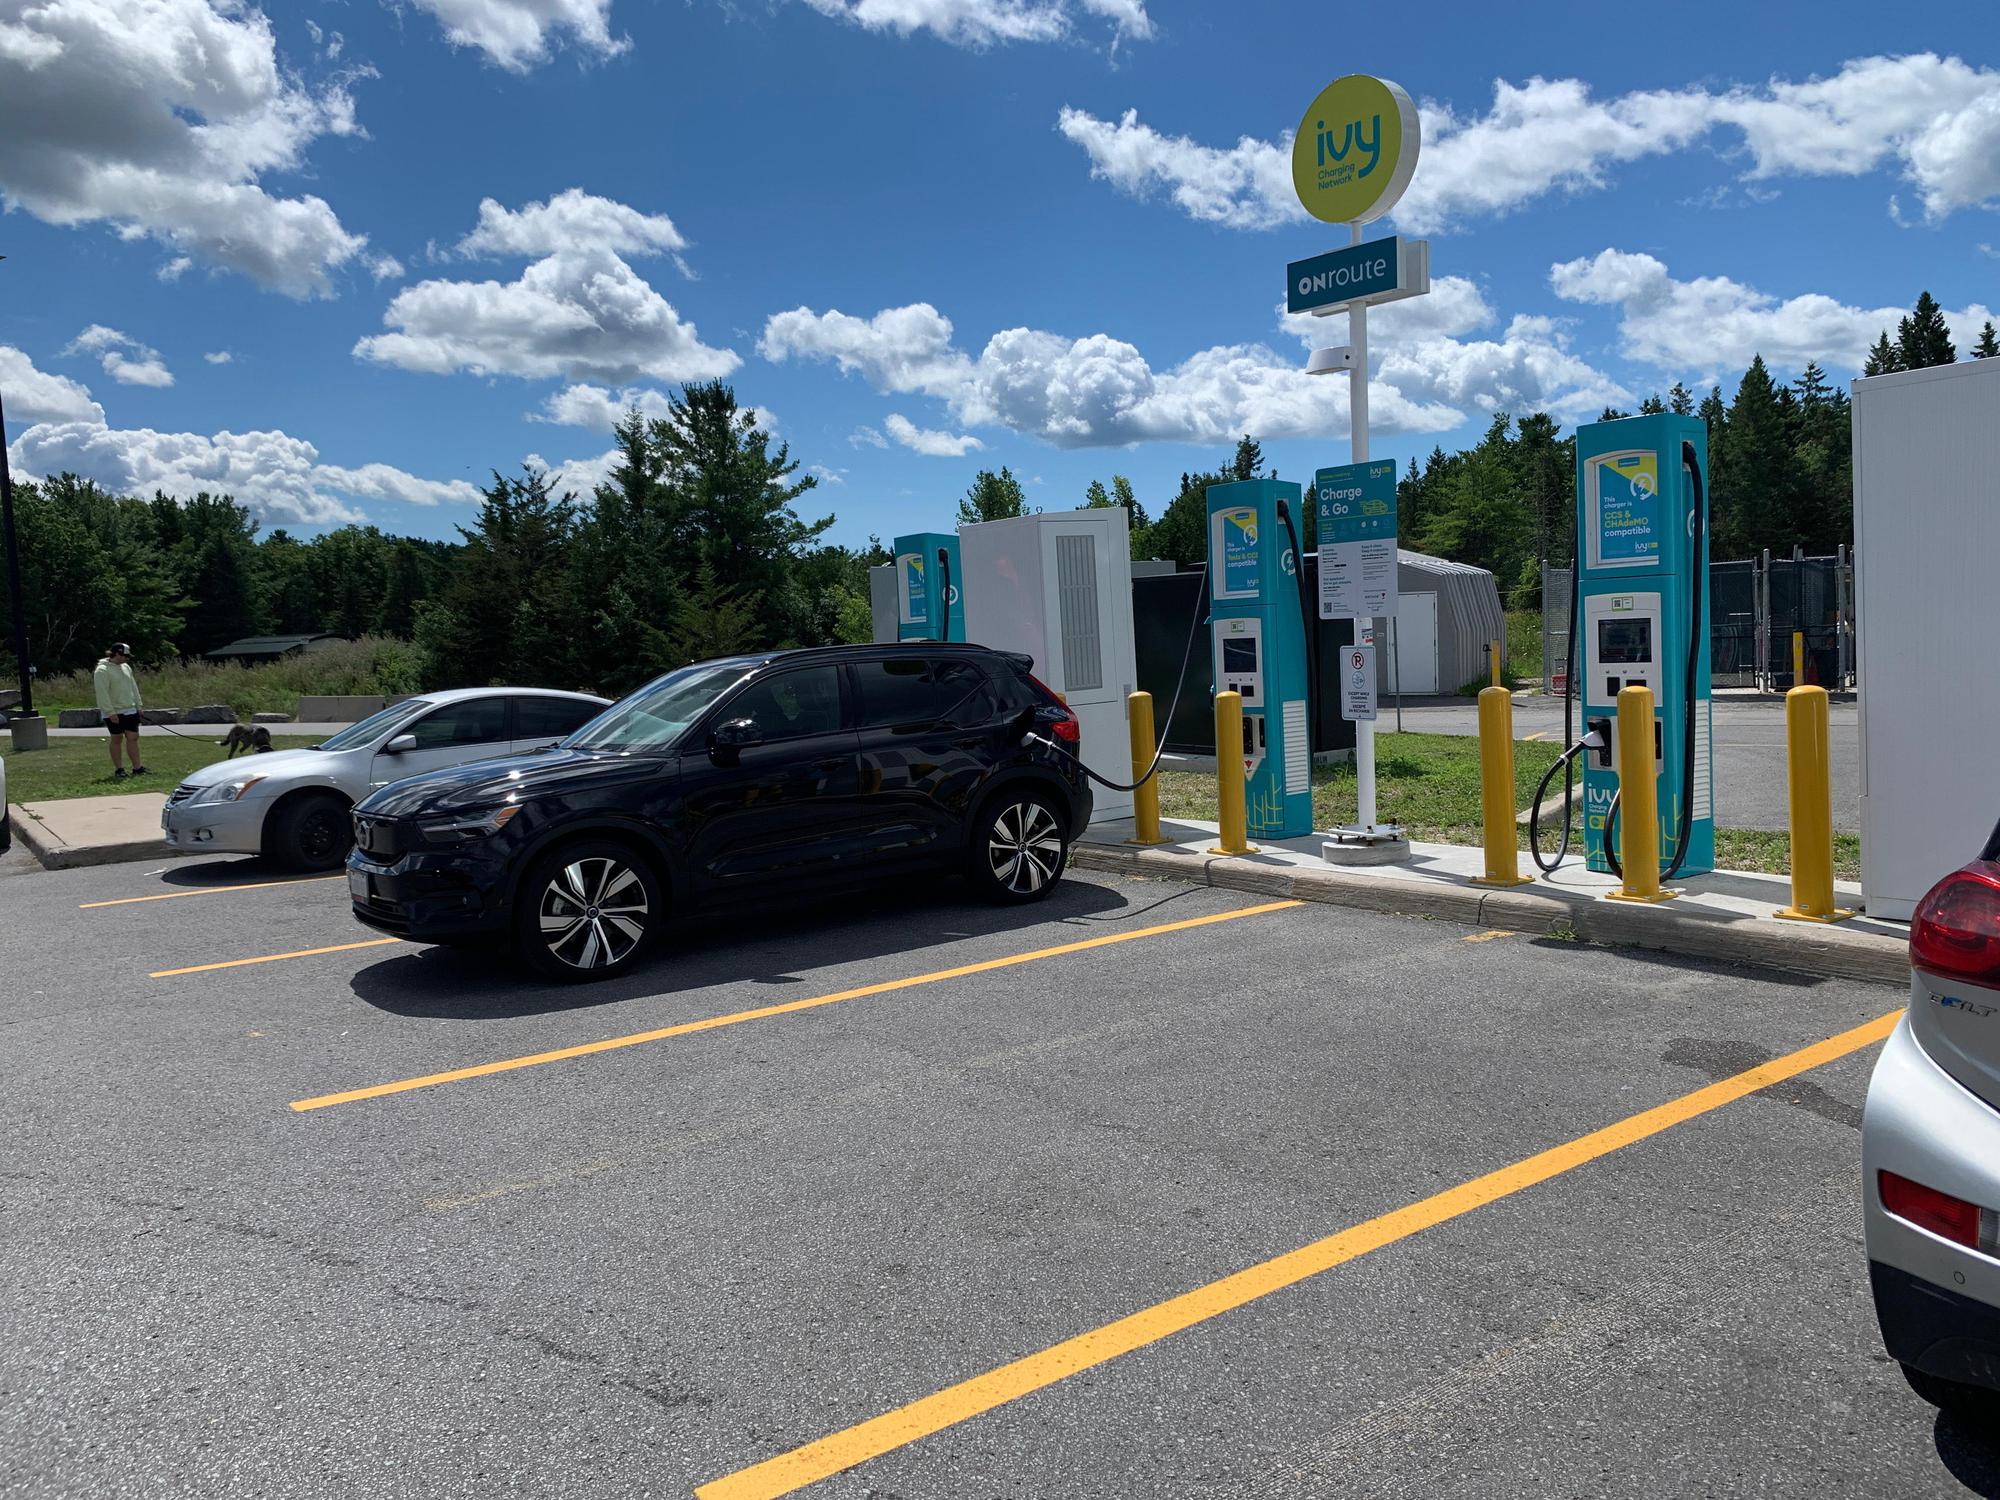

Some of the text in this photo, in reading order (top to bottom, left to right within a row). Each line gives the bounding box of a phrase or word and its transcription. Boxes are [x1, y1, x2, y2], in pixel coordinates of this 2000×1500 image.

[1317, 114, 1380, 179] ivy
[1318, 162, 1355, 180] Charging
[1318, 174, 1353, 191] Network
[1298, 258, 1387, 296] ONroute
[1320, 487, 1362, 501] Charge
[1321, 502, 1349, 517] & Go
[1605, 511, 1623, 520] CCS
[1605, 517, 1649, 528] CHAdeMO
[1605, 525, 1651, 537] compatible
[1635, 541, 1648, 553] ivy
